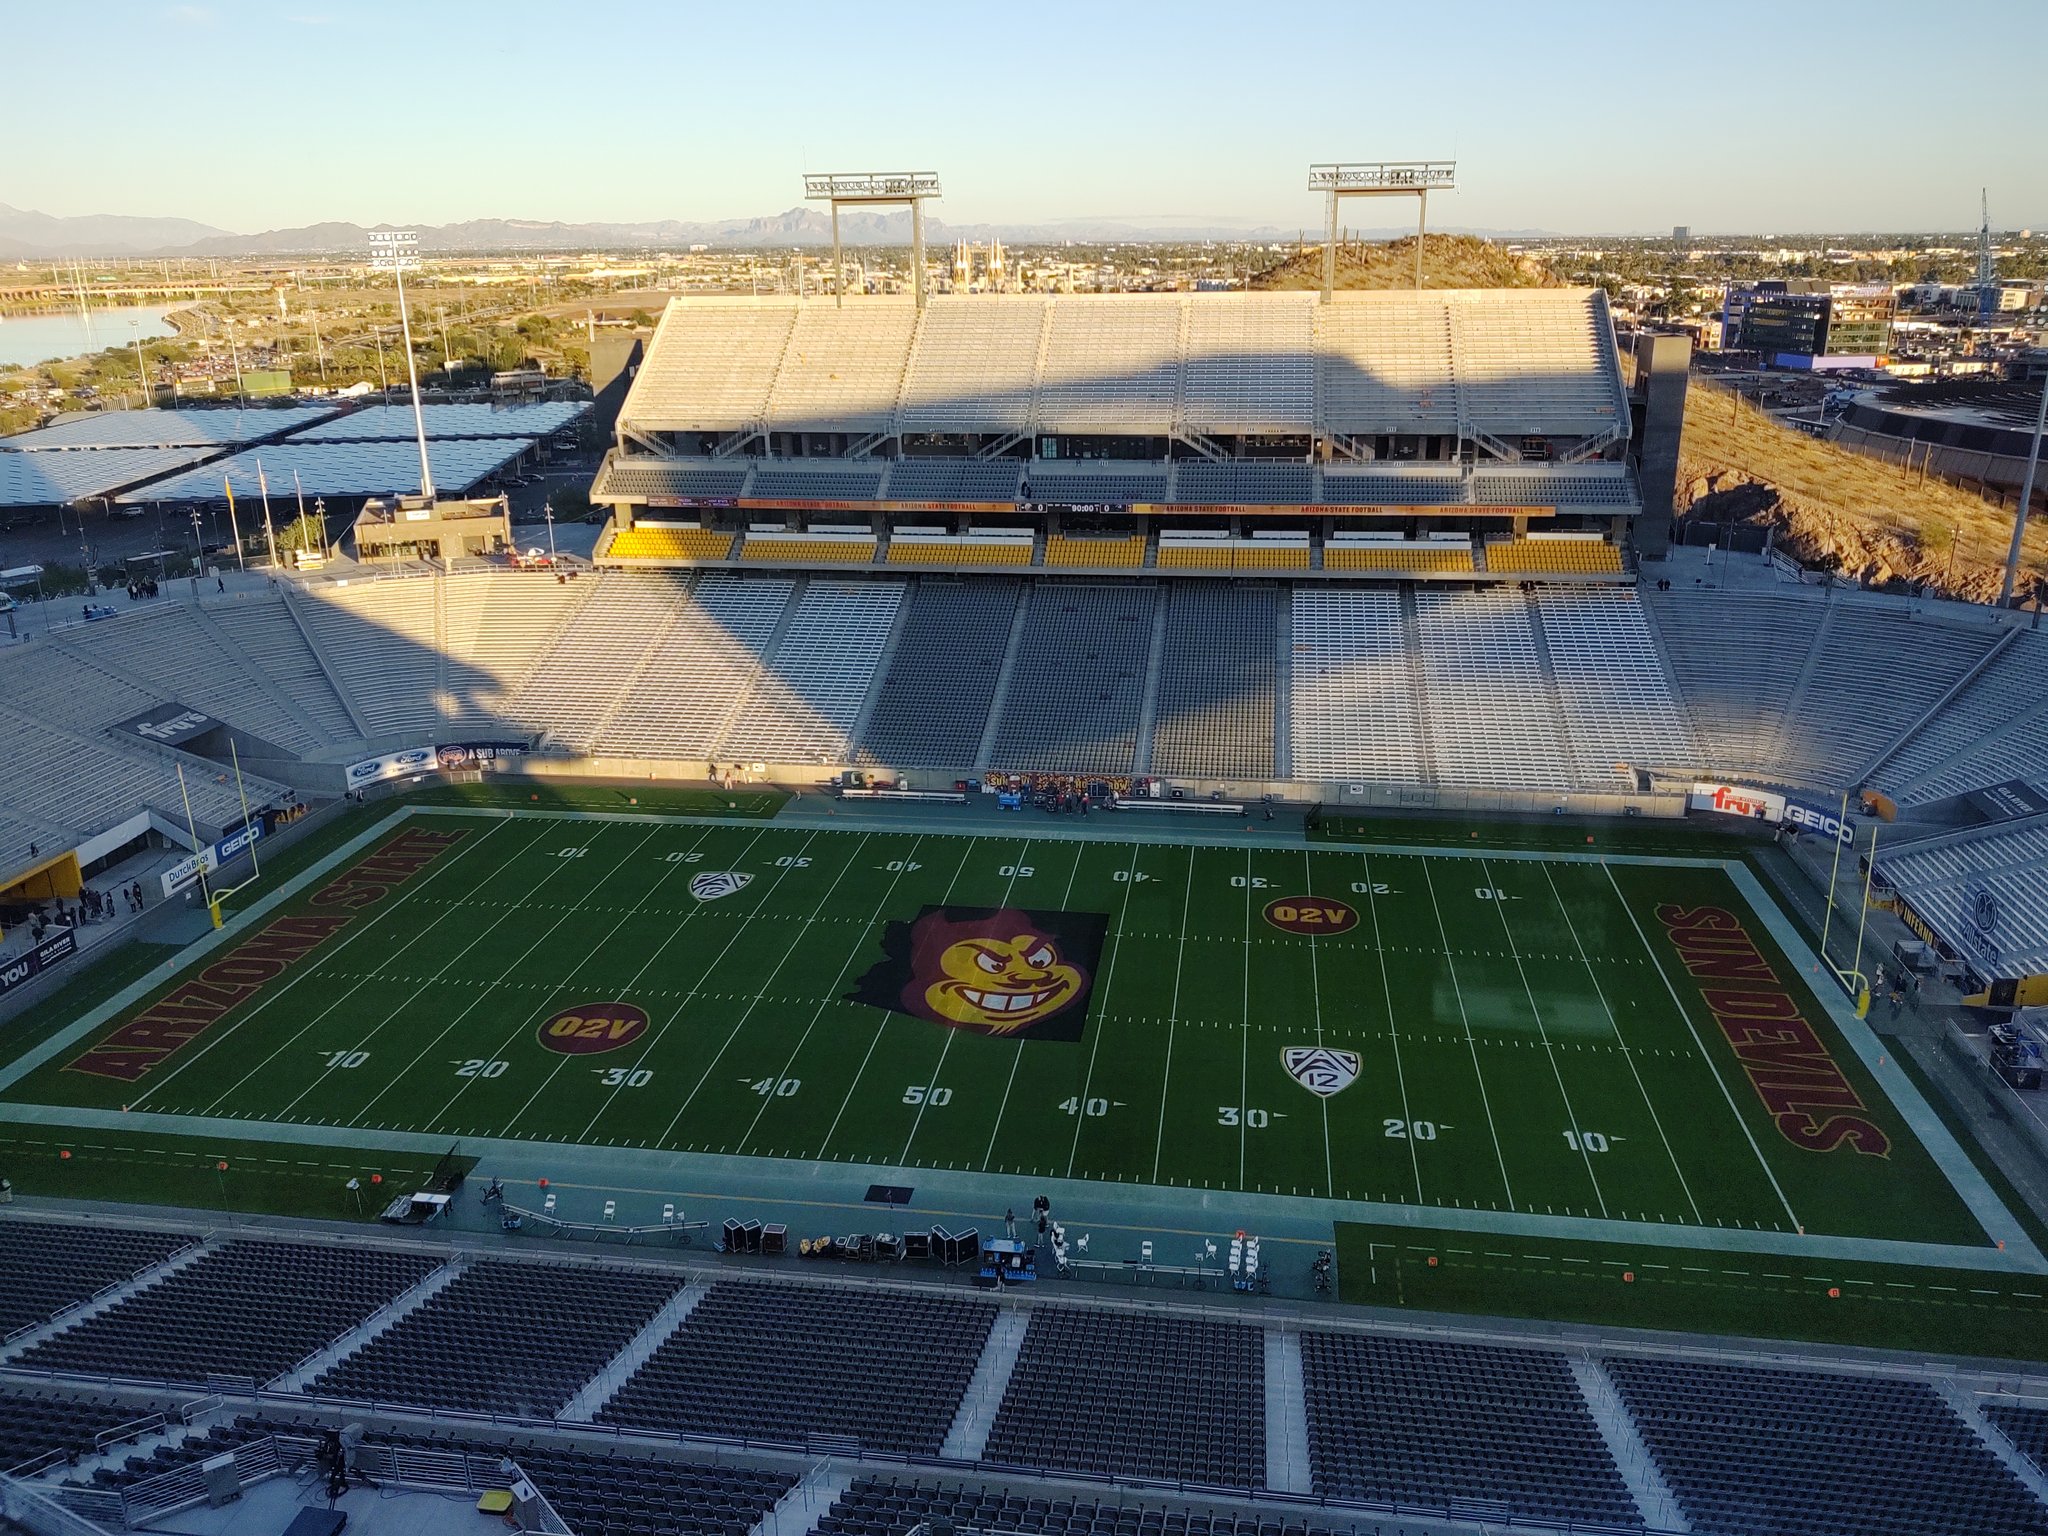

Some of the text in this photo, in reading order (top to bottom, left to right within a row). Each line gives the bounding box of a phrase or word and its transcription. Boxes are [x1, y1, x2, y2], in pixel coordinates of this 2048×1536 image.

[1165, 505, 1192, 513] ARIZONA
[1215, 505, 1246, 513] FOOTBALL
[476, 748, 494, 759] SUB
[1784, 804, 1853, 844] GEICO
[221, 826, 260, 857] GEICO
[1903, 906, 1934, 946] INFERNO
[59, 826, 475, 1082] ARIZONA STATE
[1963, 923, 1998, 966] Allstate
[0, 961, 29, 987] YOU
[1654, 902, 1892, 1160] SUN DEVILS
[325, 1051, 371, 1069] 10
[454, 1059, 510, 1079] 20
[1286, 1049, 1357, 1076] PAC
[600, 1068, 654, 1088] 30
[750, 1076, 801, 1097] 40
[1308, 1073, 1339, 1087] 12
[902, 1086, 953, 1106] 50
[1058, 1096, 1107, 1117] 40
[1217, 1107, 1269, 1129] 30
[1382, 1119, 1437, 1141] 20
[1562, 1130, 1609, 1153] 10
